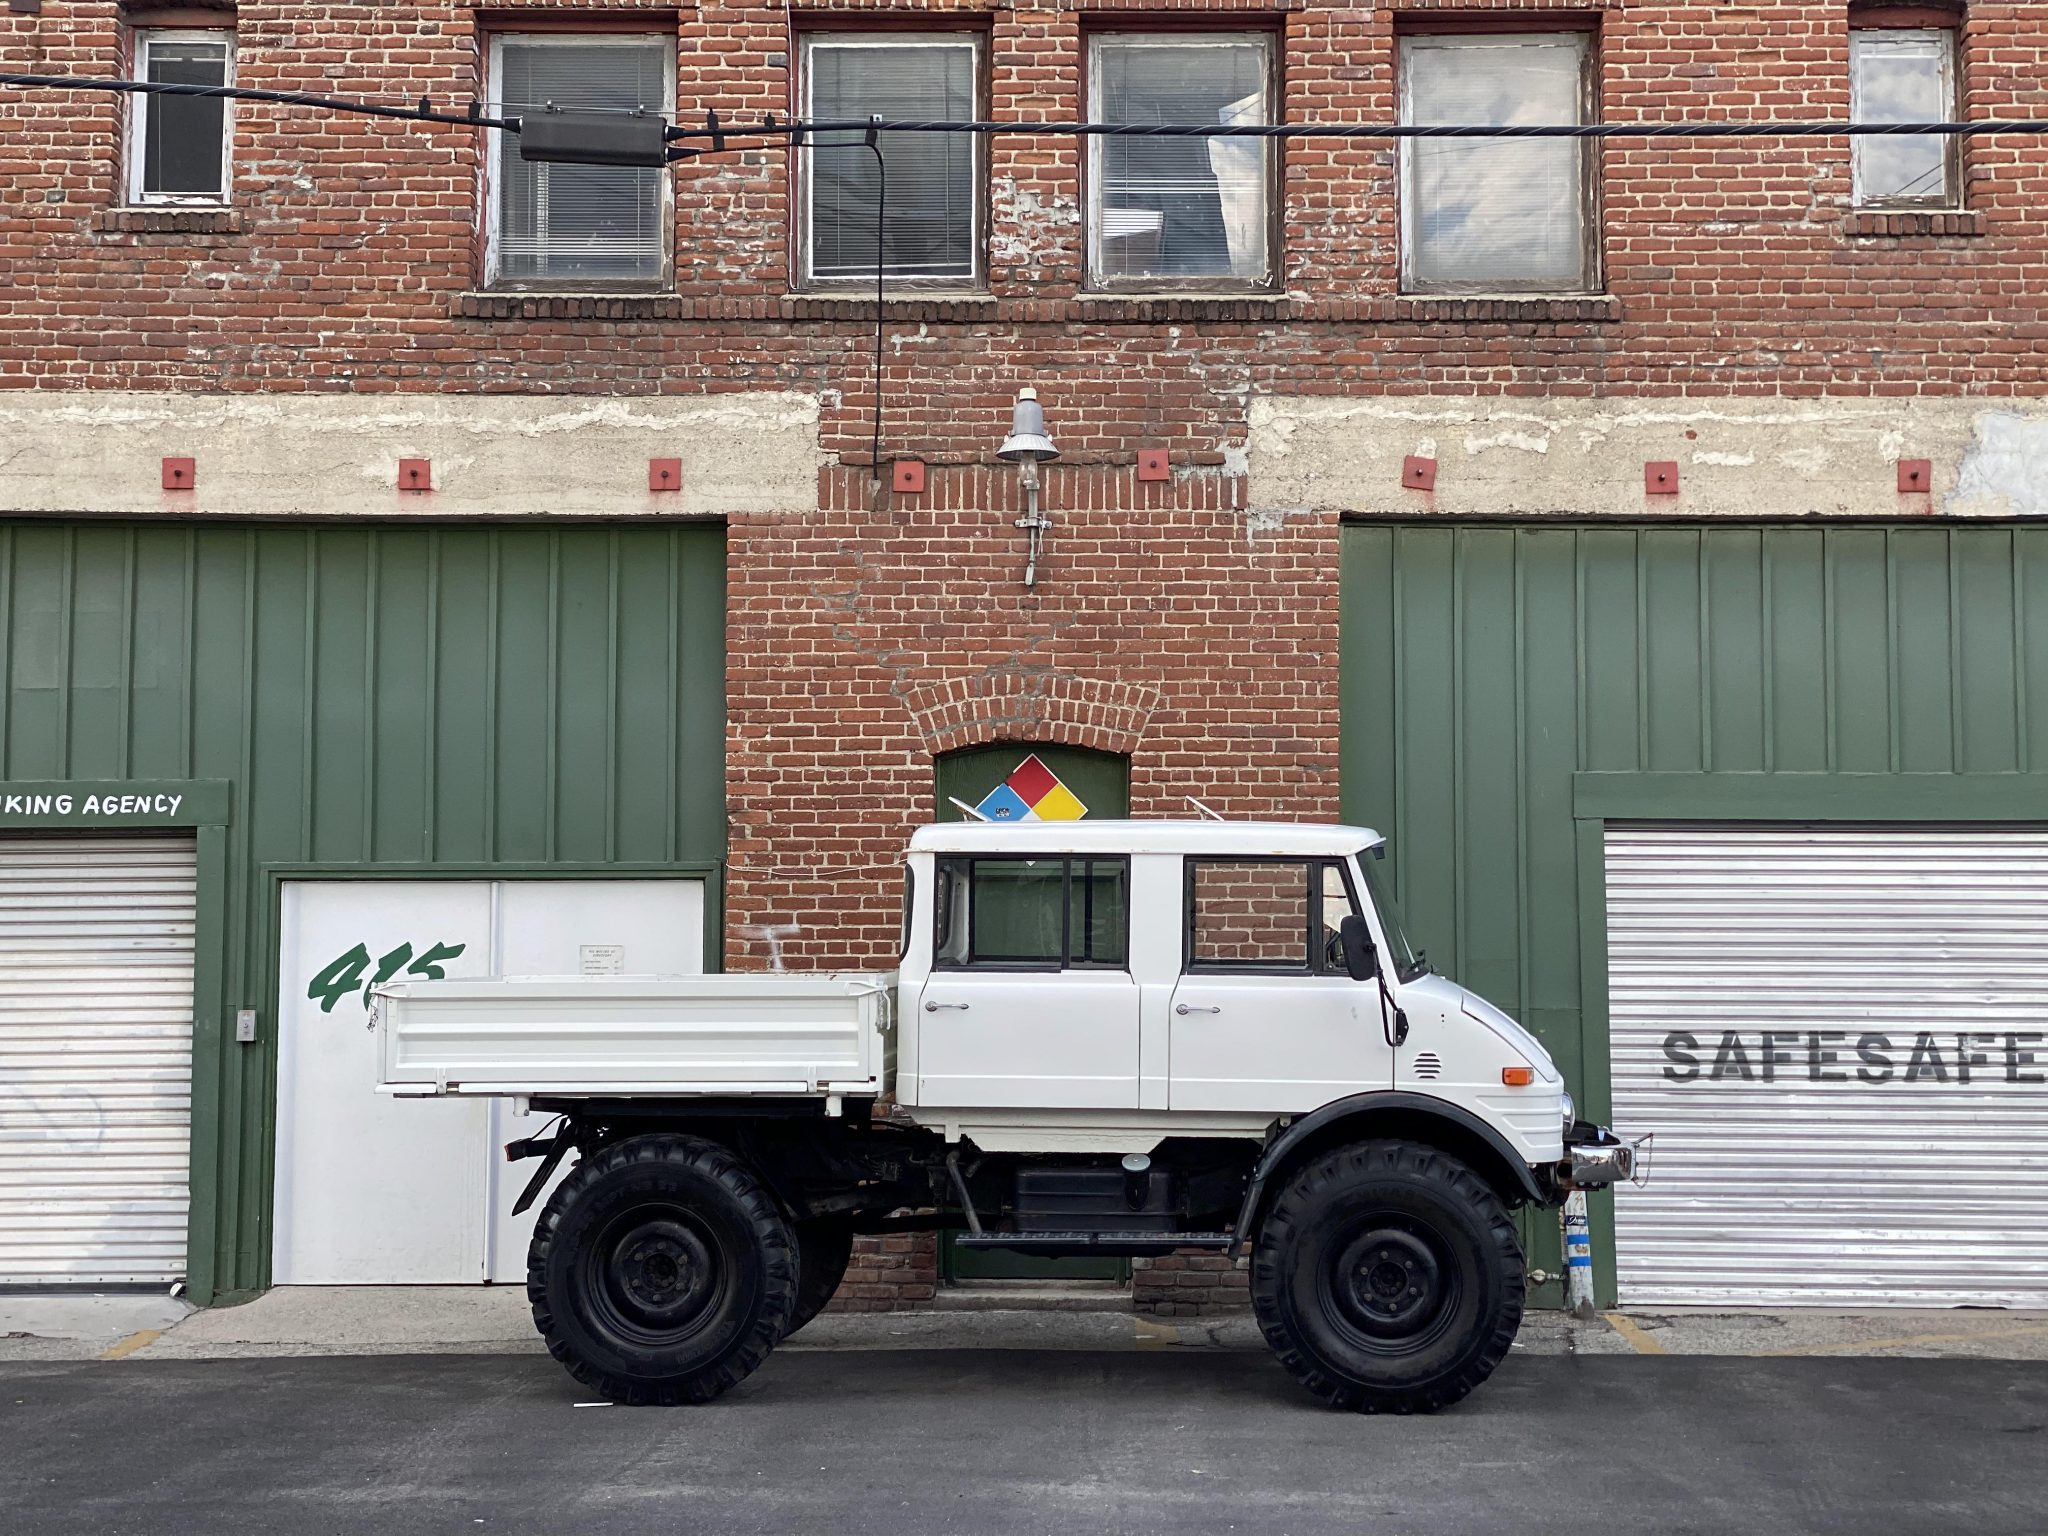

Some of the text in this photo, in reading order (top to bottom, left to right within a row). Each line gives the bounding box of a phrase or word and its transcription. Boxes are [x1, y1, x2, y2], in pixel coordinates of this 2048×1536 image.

[0, 794, 182, 817] KING AGENCY
[1662, 1030, 2045, 1085] SAFESAFE
